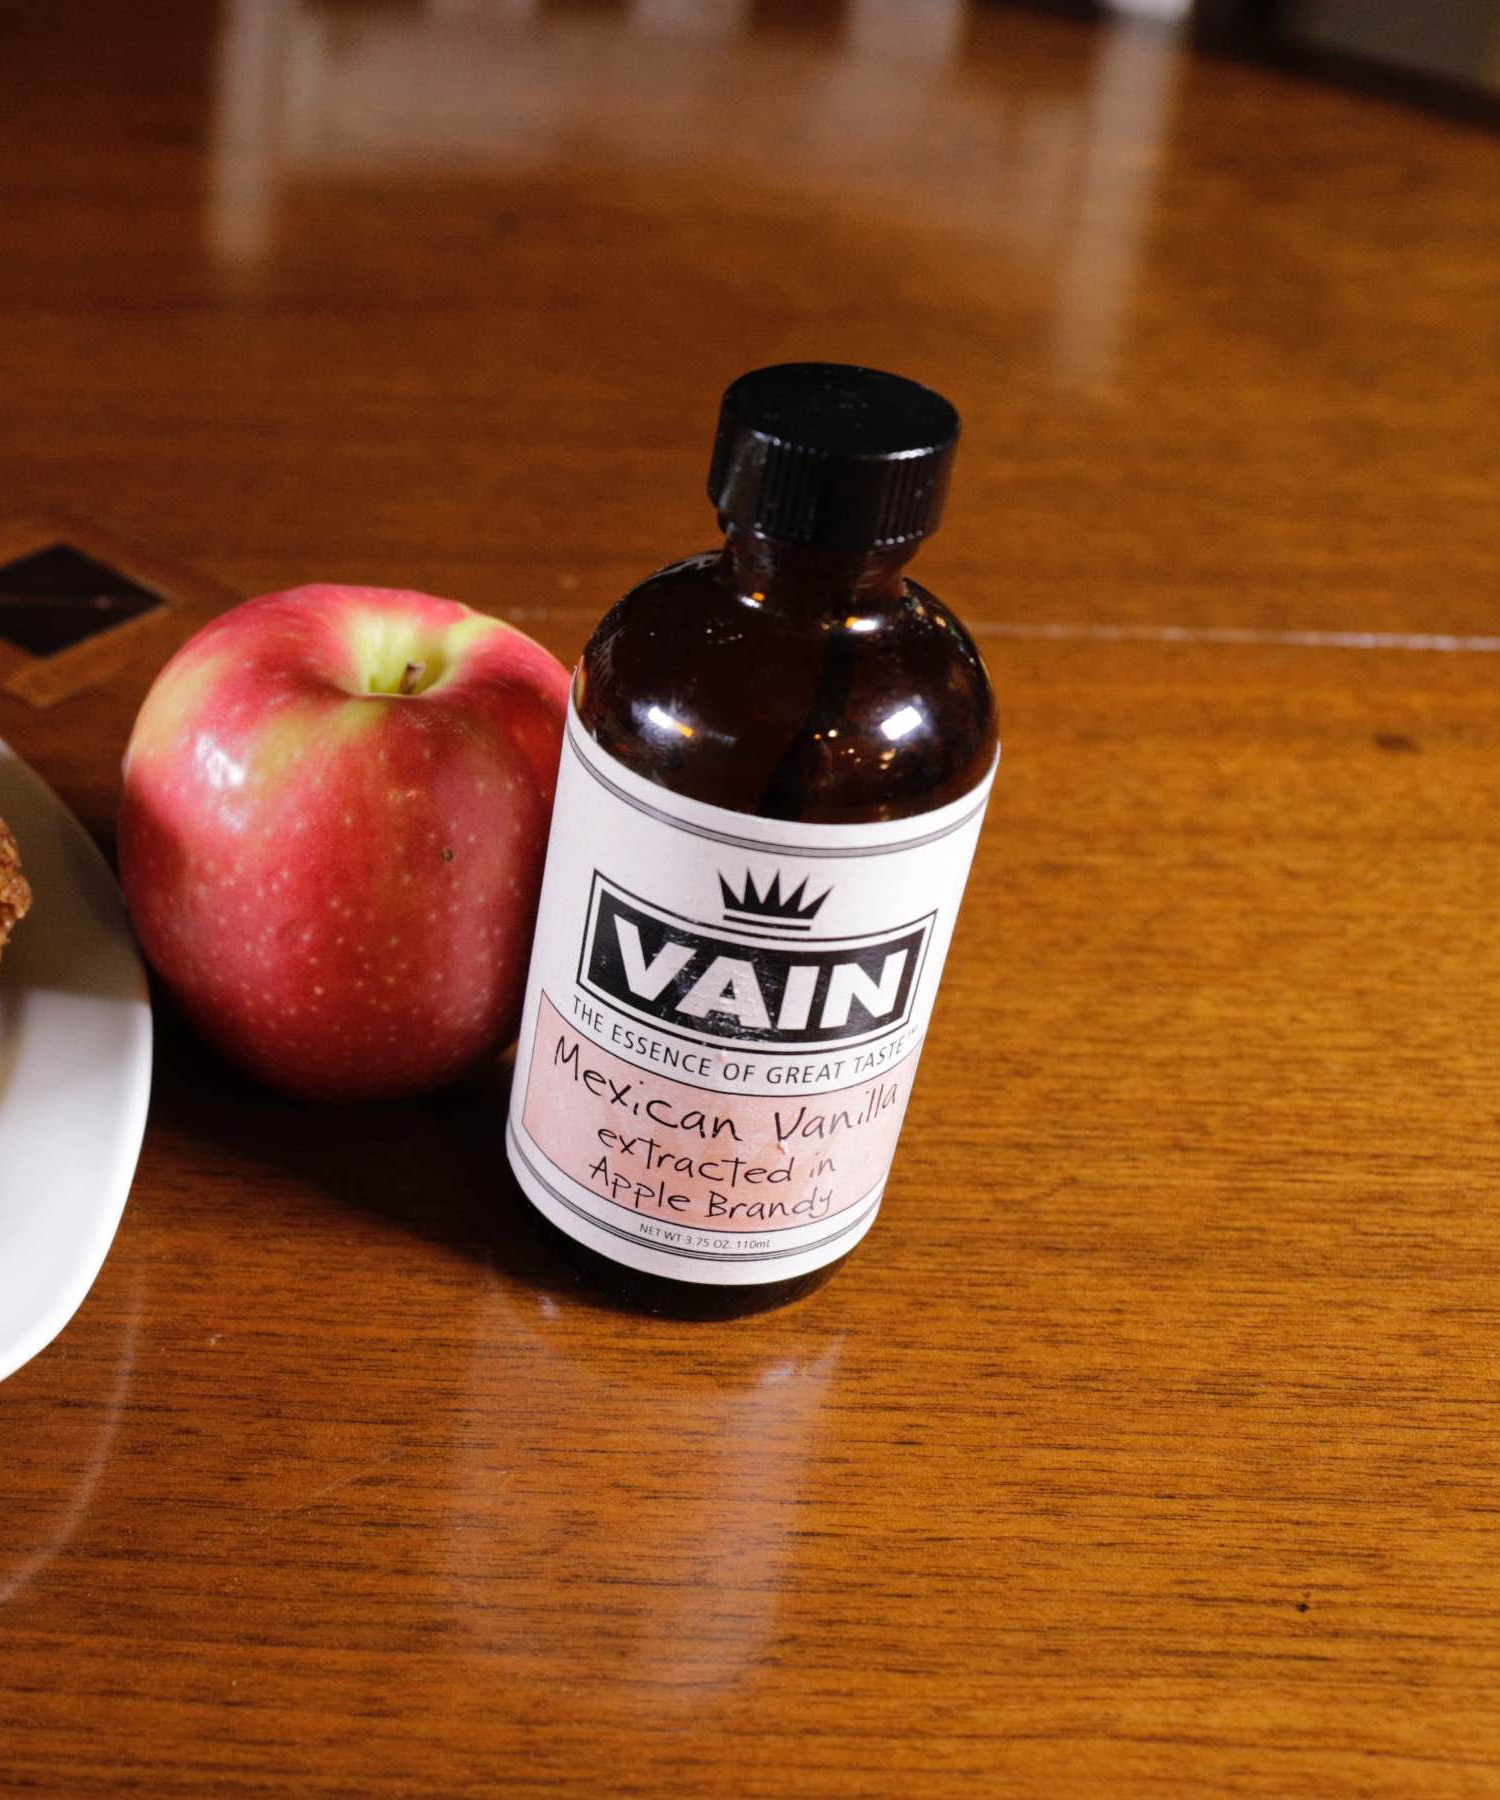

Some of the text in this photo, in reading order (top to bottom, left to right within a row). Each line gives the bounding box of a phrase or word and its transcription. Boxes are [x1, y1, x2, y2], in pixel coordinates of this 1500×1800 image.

[613, 914, 909, 1030] VAIN
[573, 994, 906, 1084] THE ESSENCE OF GREAT TASTE
[553, 1034, 898, 1143] Mexican Vanilla
[588, 1155, 832, 1220] Apple Brandy
[597, 1127, 837, 1188] extracted in
[639, 1222, 662, 1238] NET
[664, 1230, 682, 1243] WT
[685, 1235, 710, 1248] 3.75
[713, 1239, 733, 1249] OZ.
